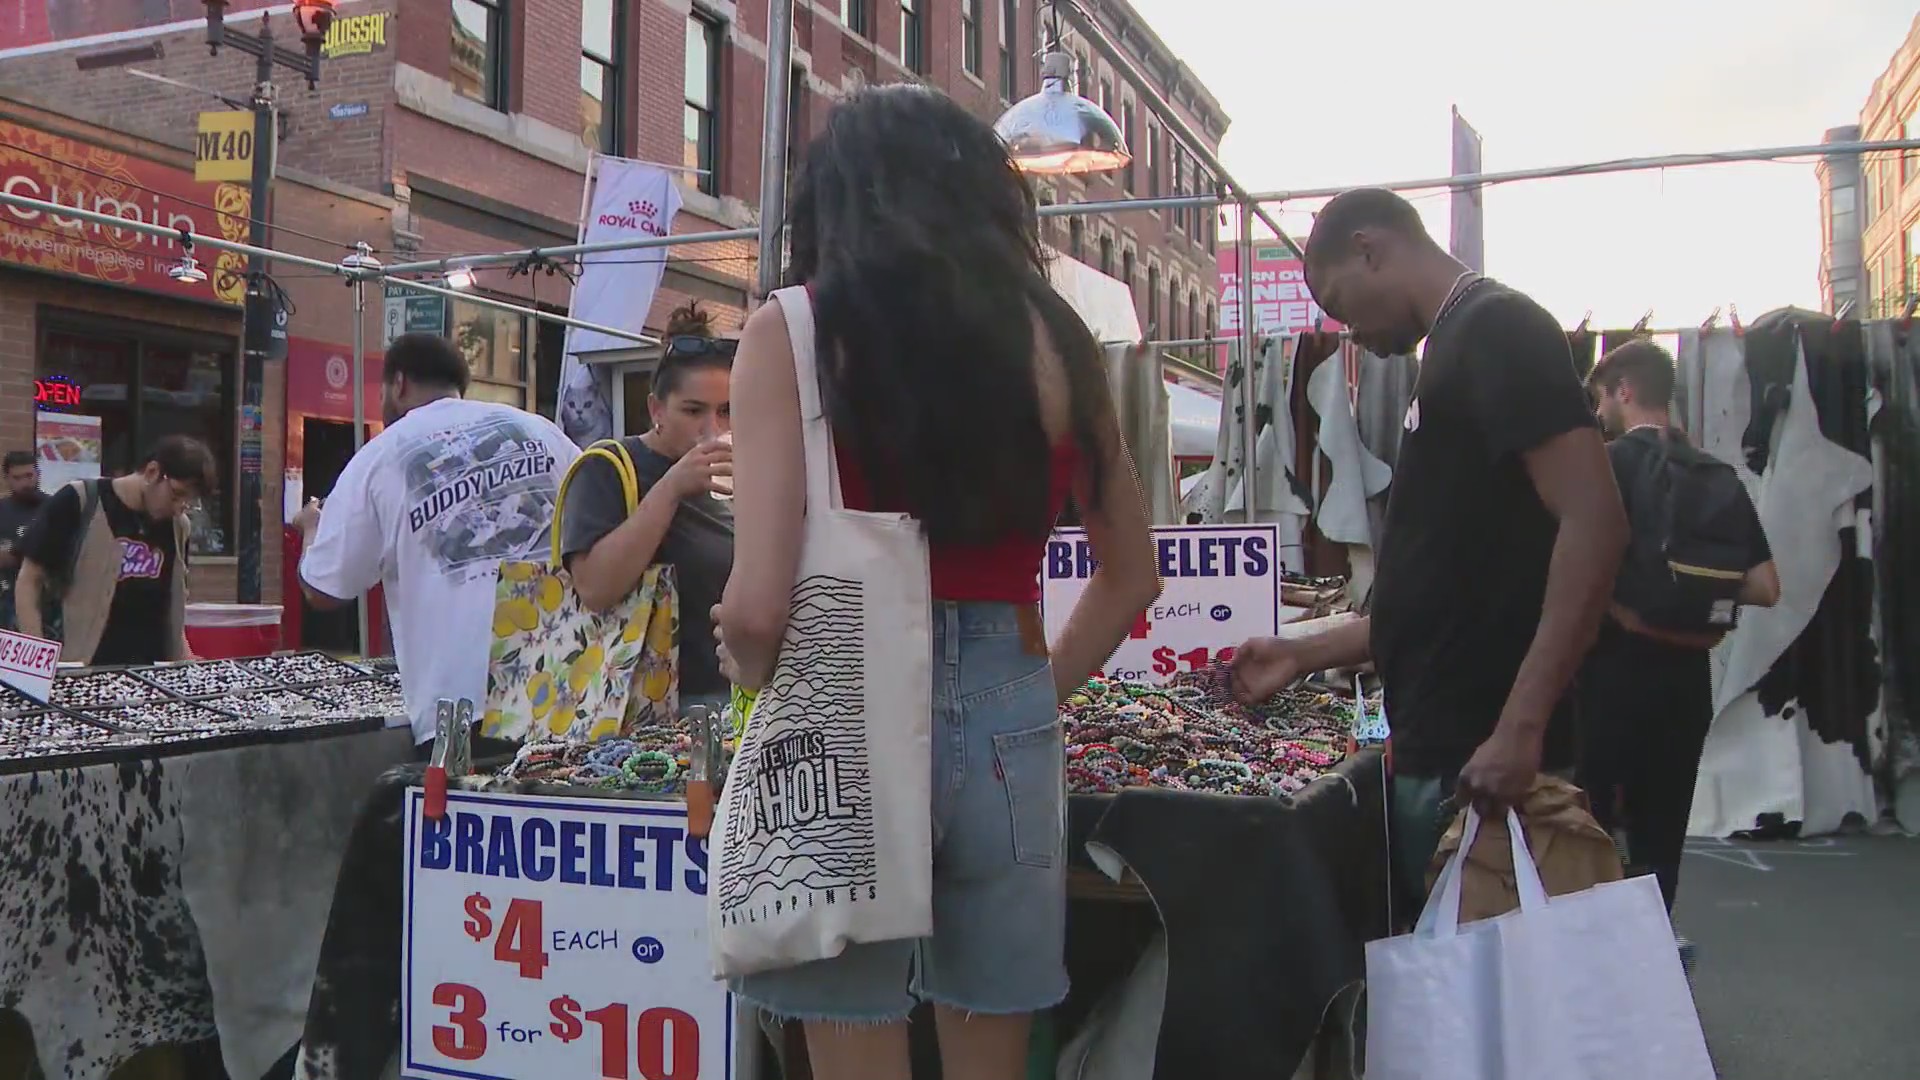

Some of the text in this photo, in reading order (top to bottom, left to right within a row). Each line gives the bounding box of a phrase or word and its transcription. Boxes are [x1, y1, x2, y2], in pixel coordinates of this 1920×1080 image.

[322, 12, 386, 51] OLOSSAL
[196, 130, 251, 161] M40
[598, 214, 637, 229] ROYAL
[5, 231, 69, 255] modern
[75, 244, 145, 270] nepalese
[388, 287, 402, 297] PAY
[525, 440, 545, 453] 91
[409, 473, 481, 534] BUDDY
[1048, 536, 1269, 578] BRELETS
[1154, 602, 1229, 620] EACH or
[11, 641, 55, 671] SILVER
[1114, 667, 1147, 681] for
[782, 730, 825, 766] HILLS
[420, 811, 708, 896] BRACELETS
[463, 891, 659, 980] $4 EACH or
[432, 982, 700, 1080] 3 for $10
